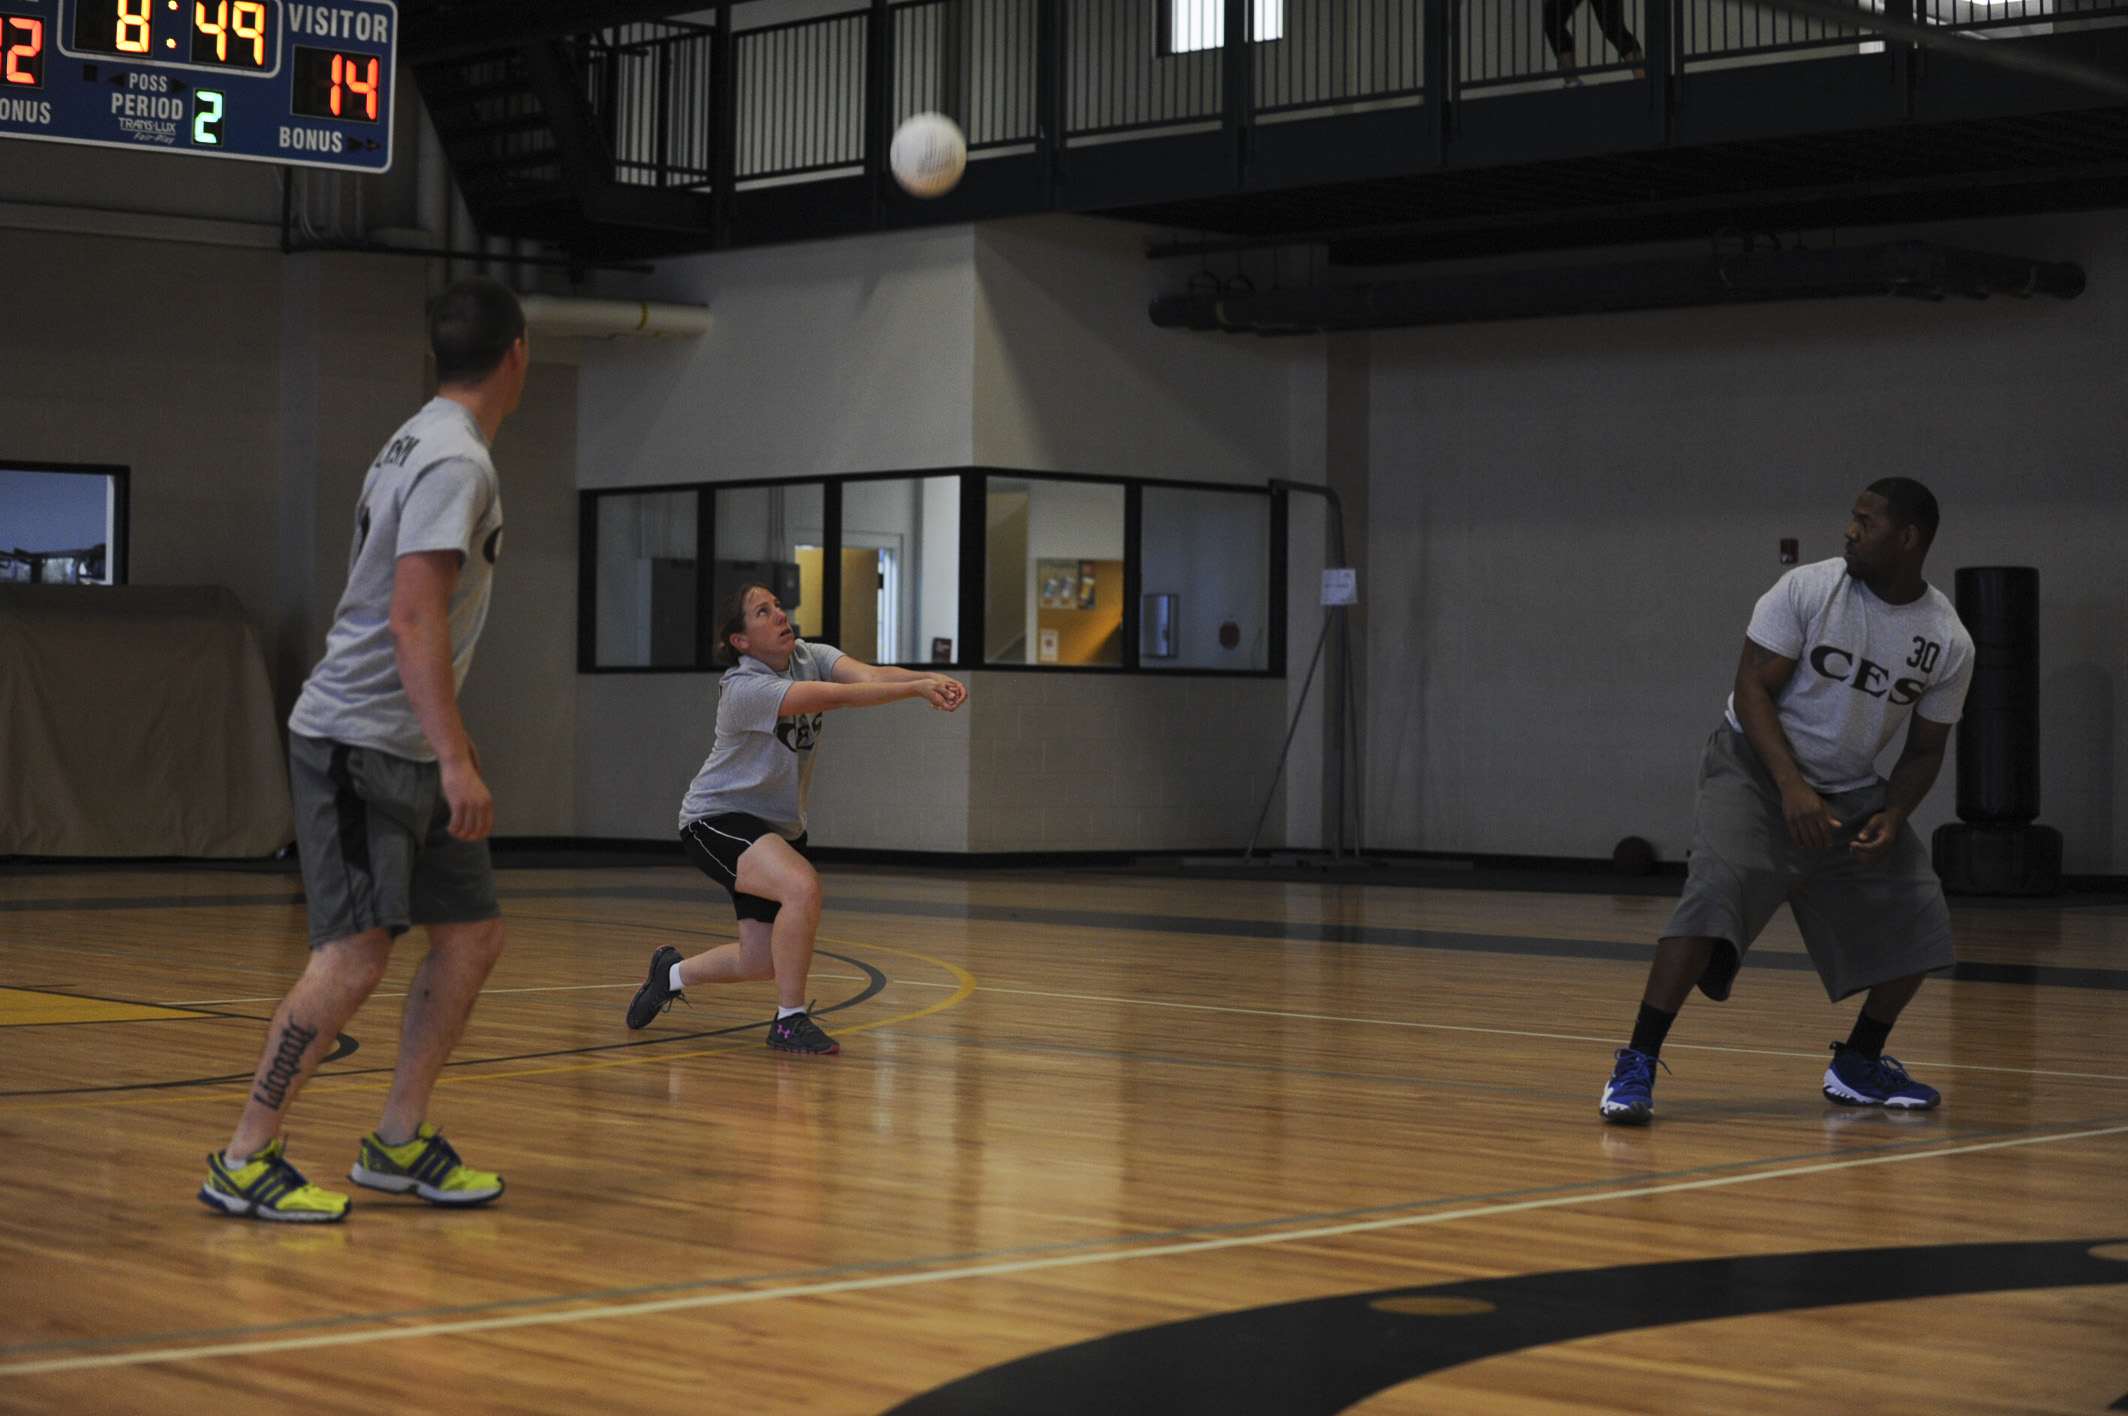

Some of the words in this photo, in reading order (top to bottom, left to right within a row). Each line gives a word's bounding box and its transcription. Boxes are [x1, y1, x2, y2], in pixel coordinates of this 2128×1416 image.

[116, 0, 265, 66] 8:49
[288, 3, 388, 44] VISITOR
[0, 17, 42, 84] 2
[129, 72, 168, 93] POSS
[330, 54, 378, 120] 14
[111, 92, 184, 121] PERIOD
[194, 91, 223, 144] 2
[279, 127, 343, 154] BONUS
[1810, 645, 1926, 706] CES
[1906, 635, 1941, 674] 30
